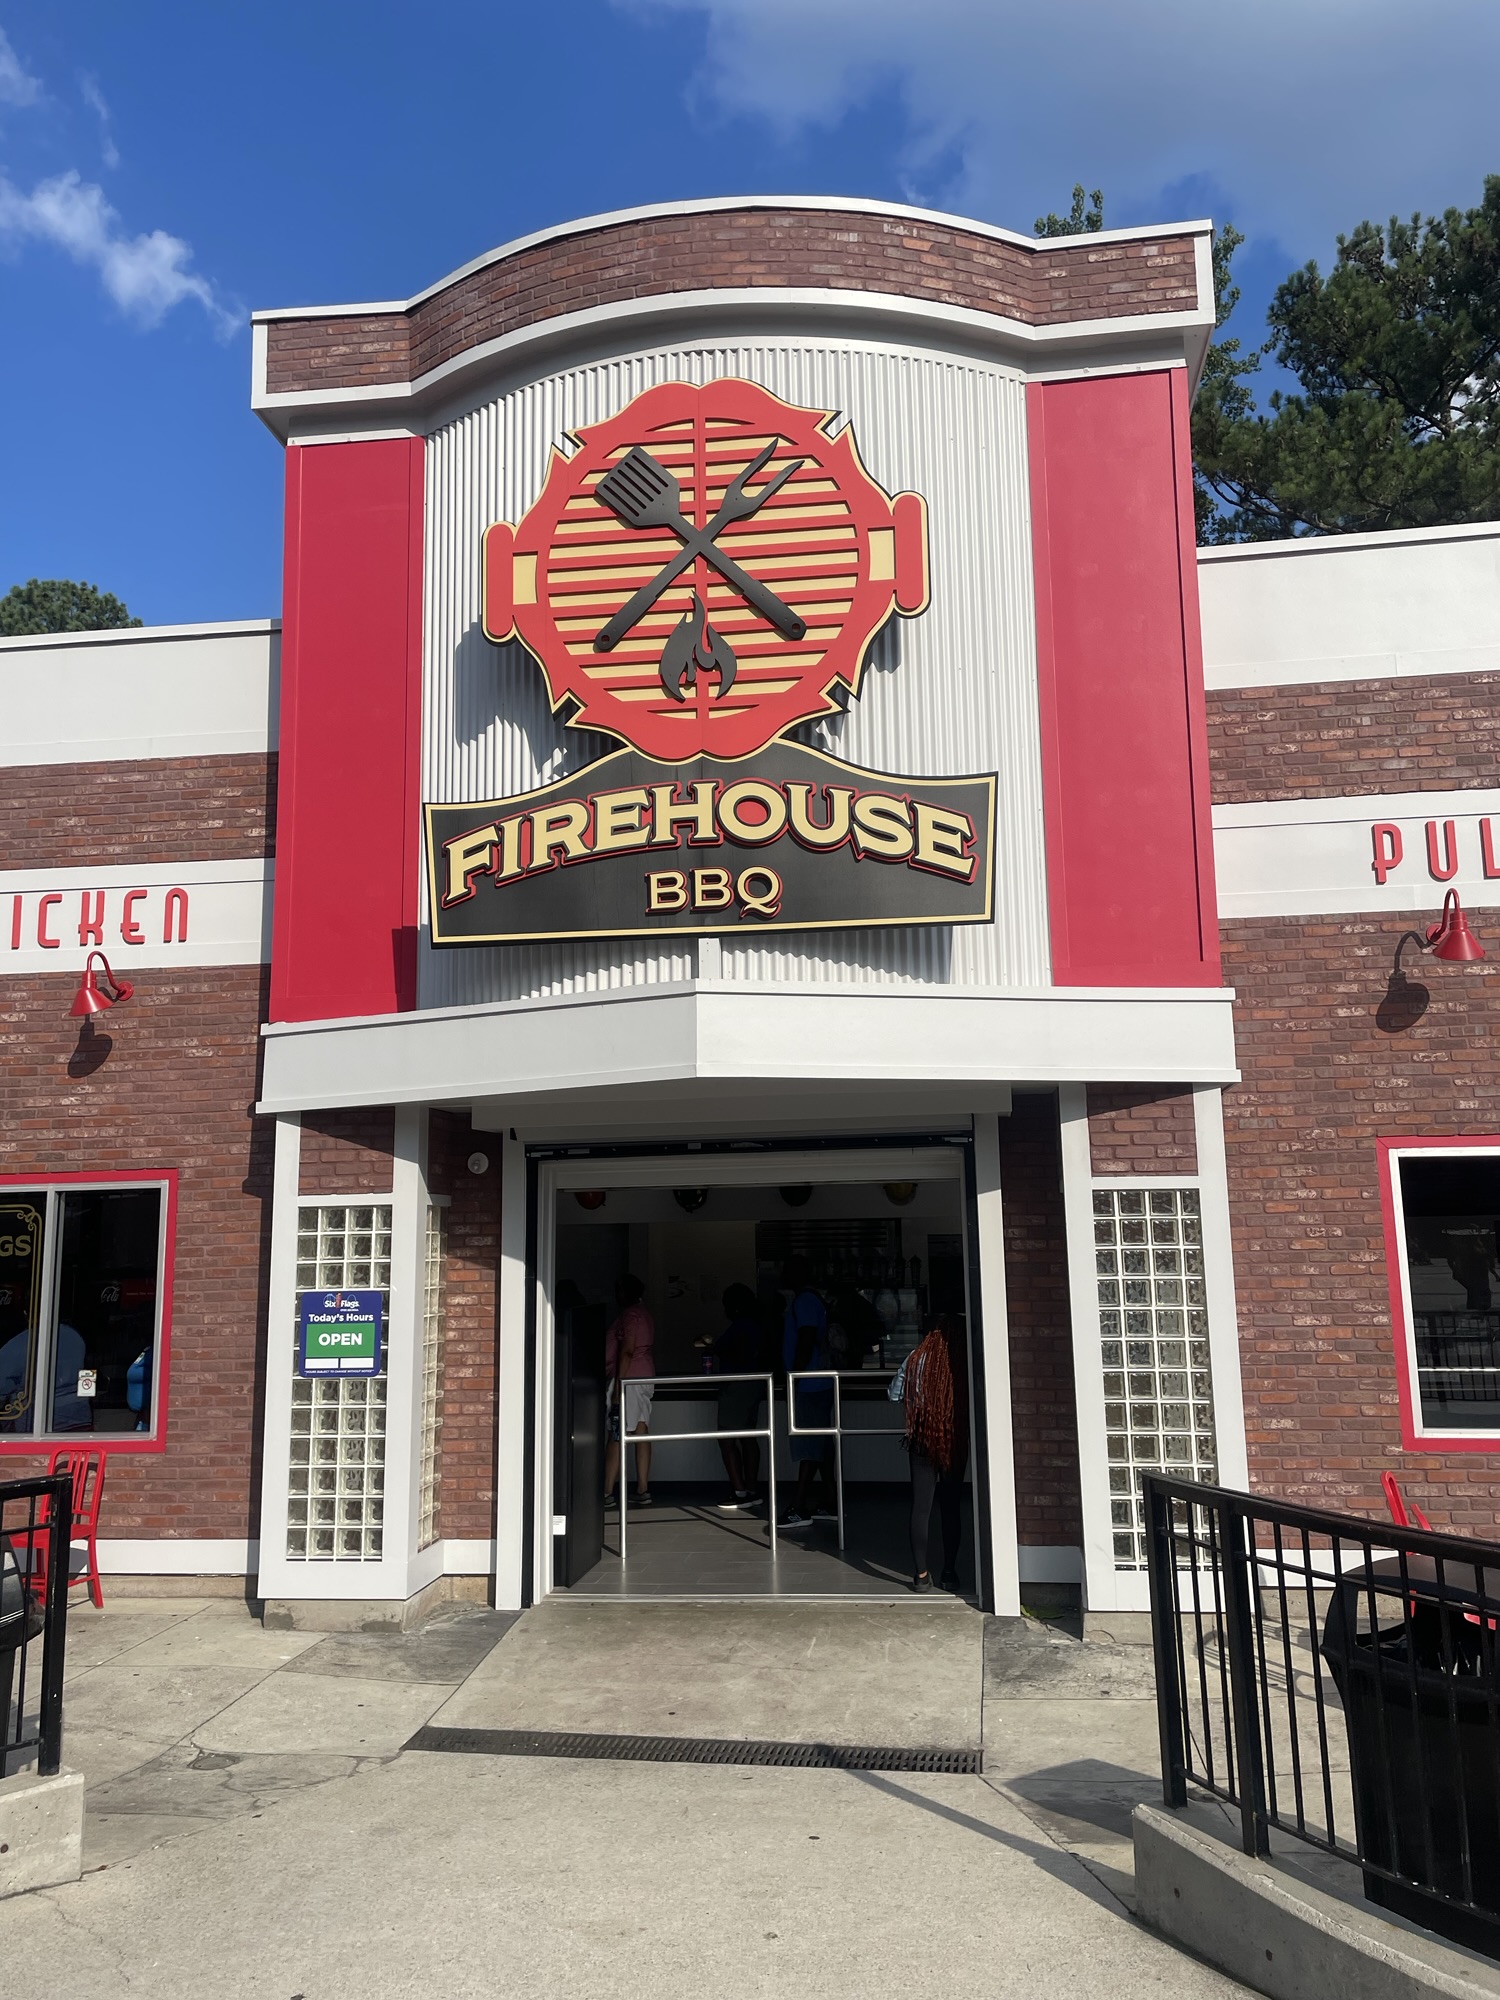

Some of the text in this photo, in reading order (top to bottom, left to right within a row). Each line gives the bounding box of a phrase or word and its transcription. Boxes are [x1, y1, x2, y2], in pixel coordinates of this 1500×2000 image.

[442, 778, 979, 908] FIREHOUSE
[645, 865, 783, 919] BBQ
[11, 887, 189, 950] ICKEN
[308, 1313, 374, 1323] Today's Hours
[324, 1299, 360, 1309] Six Flags
[318, 1333, 363, 1346] OPEN
